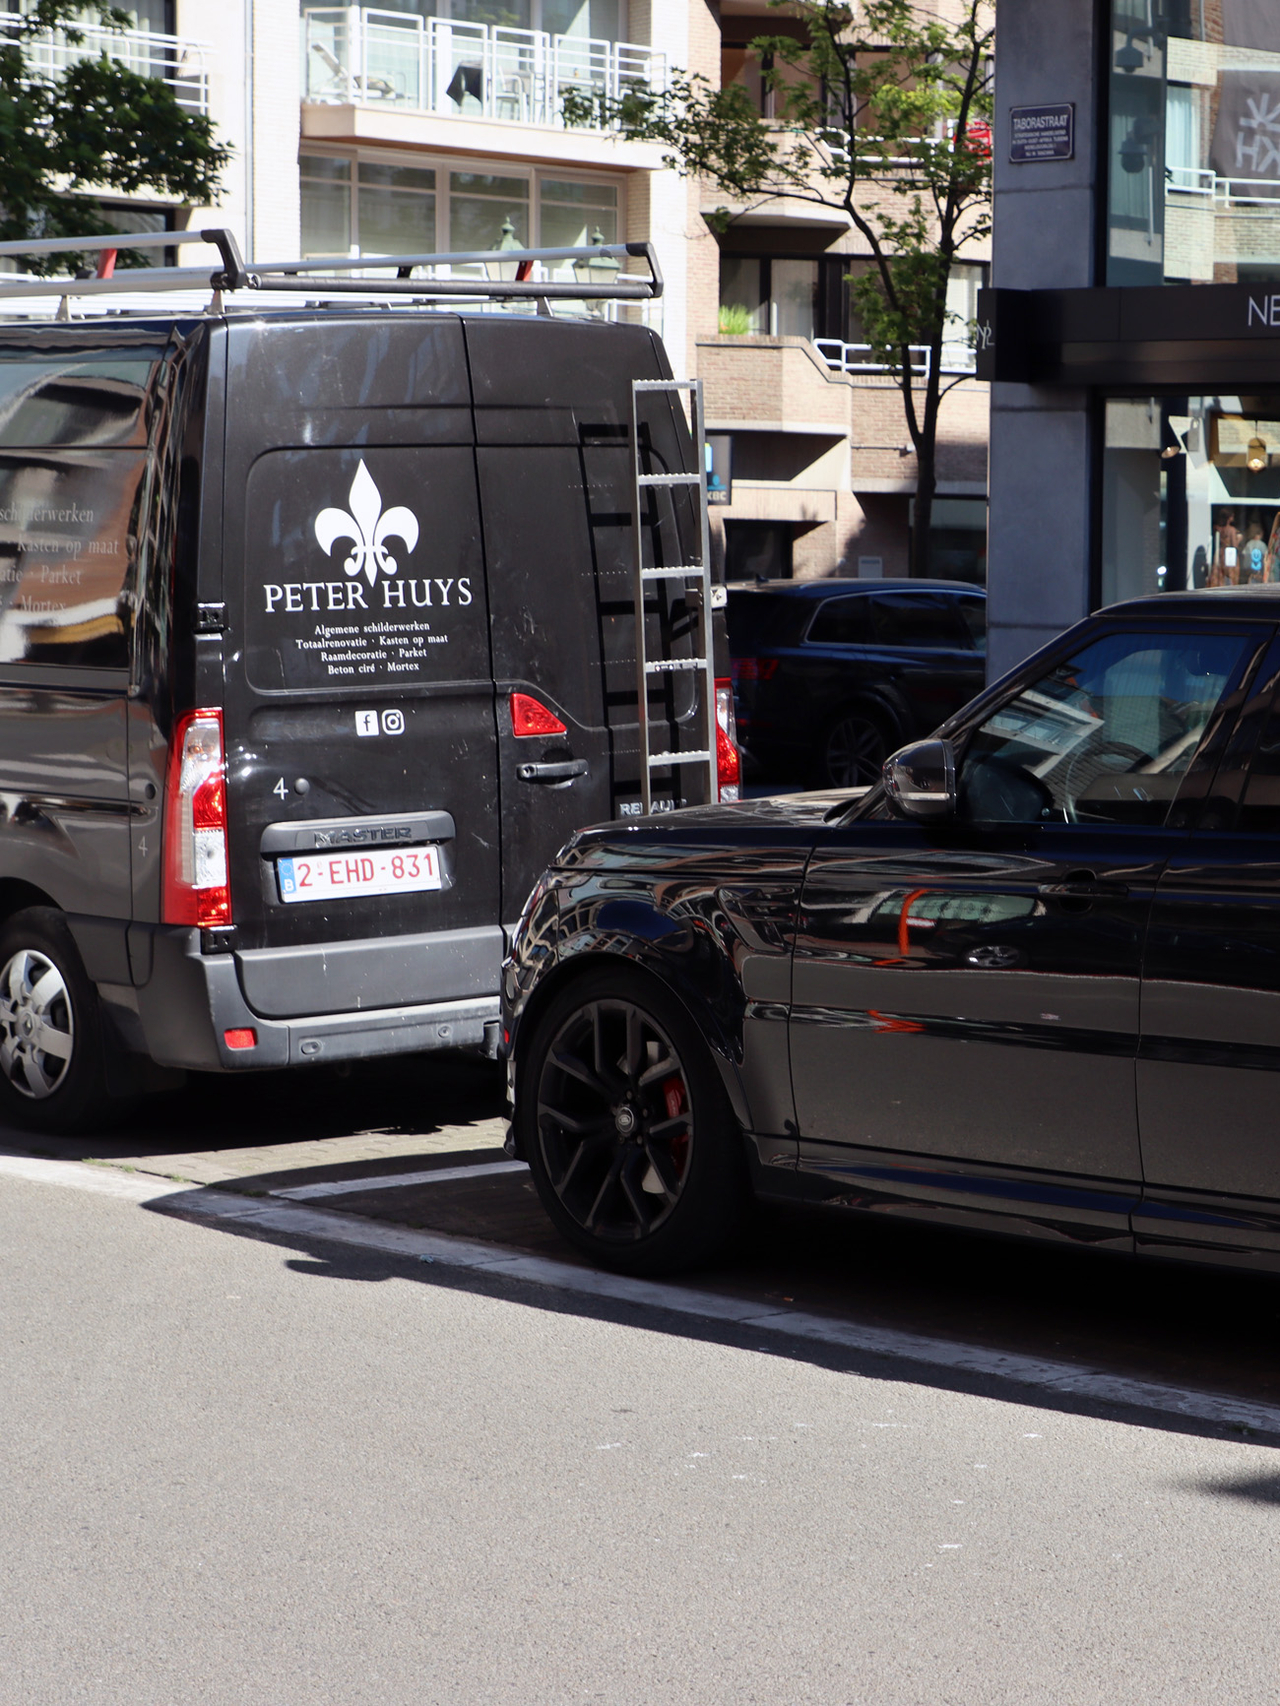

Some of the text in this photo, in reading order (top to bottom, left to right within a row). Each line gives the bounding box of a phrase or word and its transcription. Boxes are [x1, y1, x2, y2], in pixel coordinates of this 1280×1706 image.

[1013, 115, 1068, 130] TABORASTRAAT
[88, 540, 119, 555] maat
[41, 565, 82, 585] Parket
[263, 577, 473, 613] PETER HUYS
[314, 621, 430, 638] Algemene schilderwerken
[295, 634, 448, 650] Totaalrenovatie Kasten op maat
[321, 648, 427, 662] Raamdecoratie Parket
[327, 662, 420, 675] Beton ciré Mortex
[273, 777, 288, 800] 4
[313, 826, 411, 848] MASTER
[138, 836, 149, 857] 4
[297, 853, 433, 887] 2-EHD-831
[284, 878, 294, 892] B
